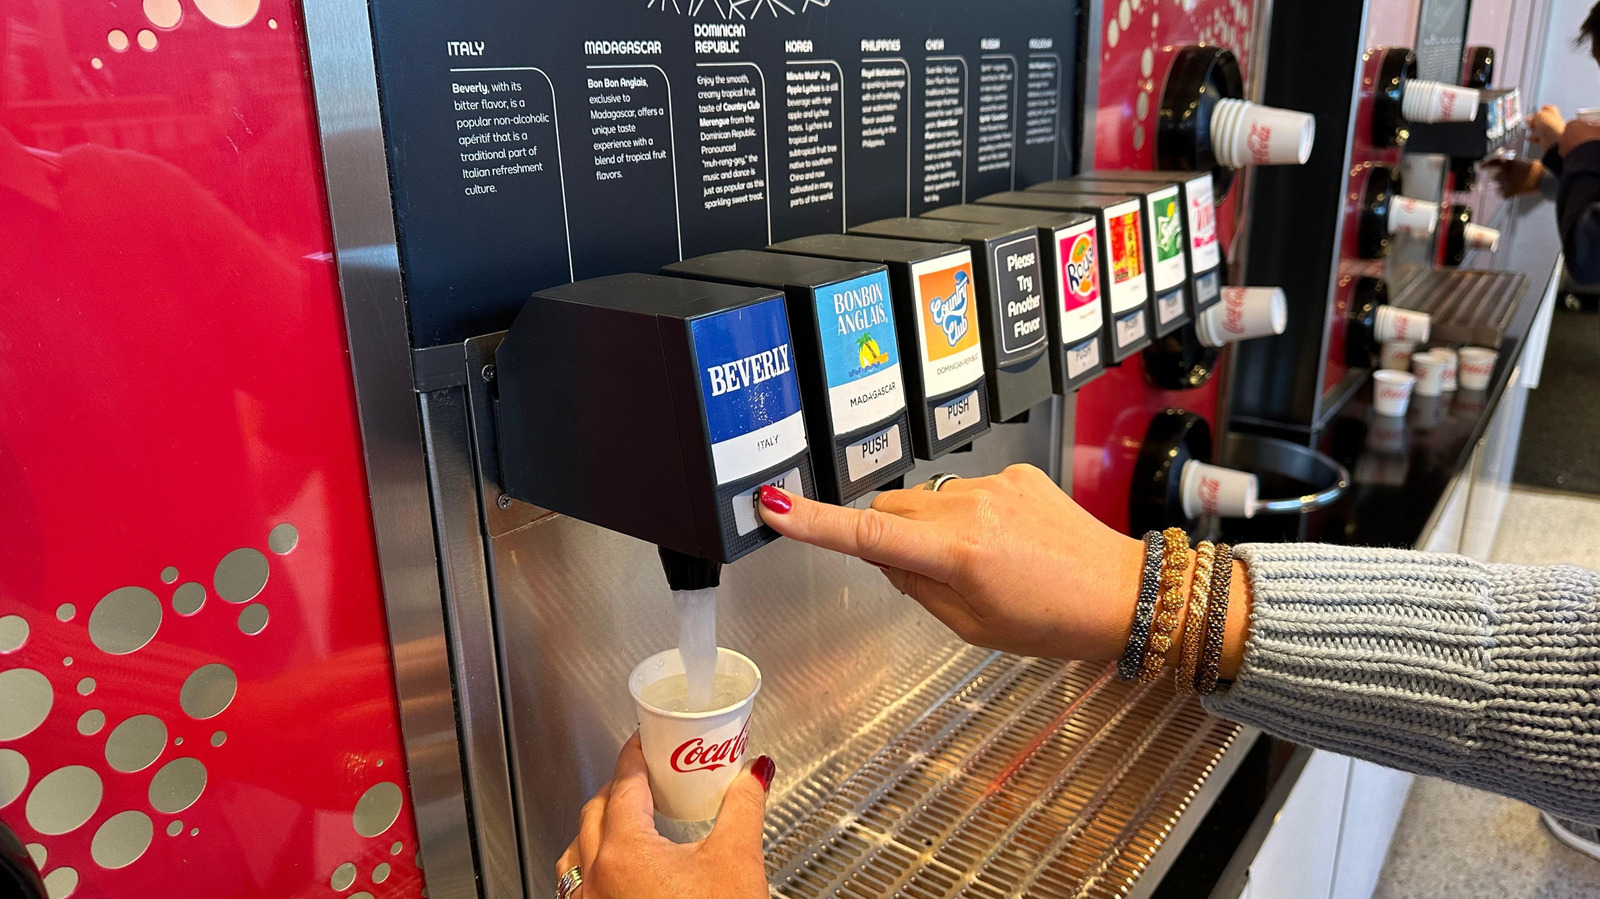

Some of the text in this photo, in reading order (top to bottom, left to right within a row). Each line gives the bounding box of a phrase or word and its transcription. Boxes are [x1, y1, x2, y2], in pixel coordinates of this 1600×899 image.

[694, 24, 746, 37] DOMINICAN
[448, 41, 484, 56] ITALY
[585, 41, 662, 54] MADAGASCAR
[695, 40, 739, 53] REPUBLIC
[785, 40, 813, 53] KOREA
[588, 77, 648, 89] Bon Bon Anglais,
[697, 76, 714, 86] Enjoy
[715, 75, 725, 84] the
[452, 82, 522, 95] Beverly, with its
[698, 87, 756, 100] creamy tropical fruit
[454, 100, 479, 111] bitter
[481, 99, 509, 109] flavor,
[510, 98, 518, 108] is
[589, 94, 630, 104] exclusive to
[699, 100, 760, 113] taste of Country Club
[590, 109, 636, 120] Madagascar,
[638, 107, 658, 116] offers
[456, 113, 549, 130] popular non-alcoholic
[699, 115, 754, 128] Merengue from the
[592, 124, 636, 136] unique taste
[700, 128, 756, 141] Dominican Republic.
[459, 133, 490, 147] apéritif
[493, 132, 511, 142] that
[513, 131, 520, 141] is
[594, 140, 632, 152] experience
[633, 137, 647, 146] with
[460, 146, 537, 162] traditional part of
[701, 143, 736, 154] Pronounced
[595, 150, 666, 165] blend of tropical fruit
[748, 154, 758, 163] the
[462, 162, 543, 178] Italian refreshment
[596, 171, 623, 180] flavors.
[703, 172, 720, 181] music
[720, 170, 732, 180] and
[733, 169, 750, 178] dance
[465, 184, 497, 195] culture.
[704, 186, 715, 197] just
[724, 182, 745, 194] popular
[754, 178, 764, 187] this
[704, 192, 764, 210] sparkling sweet treat.
[1006, 252, 1035, 272] Please
[1017, 276, 1032, 292] Try
[930, 276, 968, 323] Country
[1008, 294, 1040, 318] Another
[943, 314, 968, 345] Club
[1014, 317, 1040, 338] Flavor
[1075, 346, 1092, 362] PUSH
[708, 344, 790, 397] BEVERLY
[936, 360, 963, 376] DOMINICAN
[850, 381, 896, 408] MADAGASCAR
[948, 398, 970, 420] PUSH
[758, 434, 780, 451] ITALY
[862, 432, 889, 458] PUSH
[752, 478, 786, 509] PH
